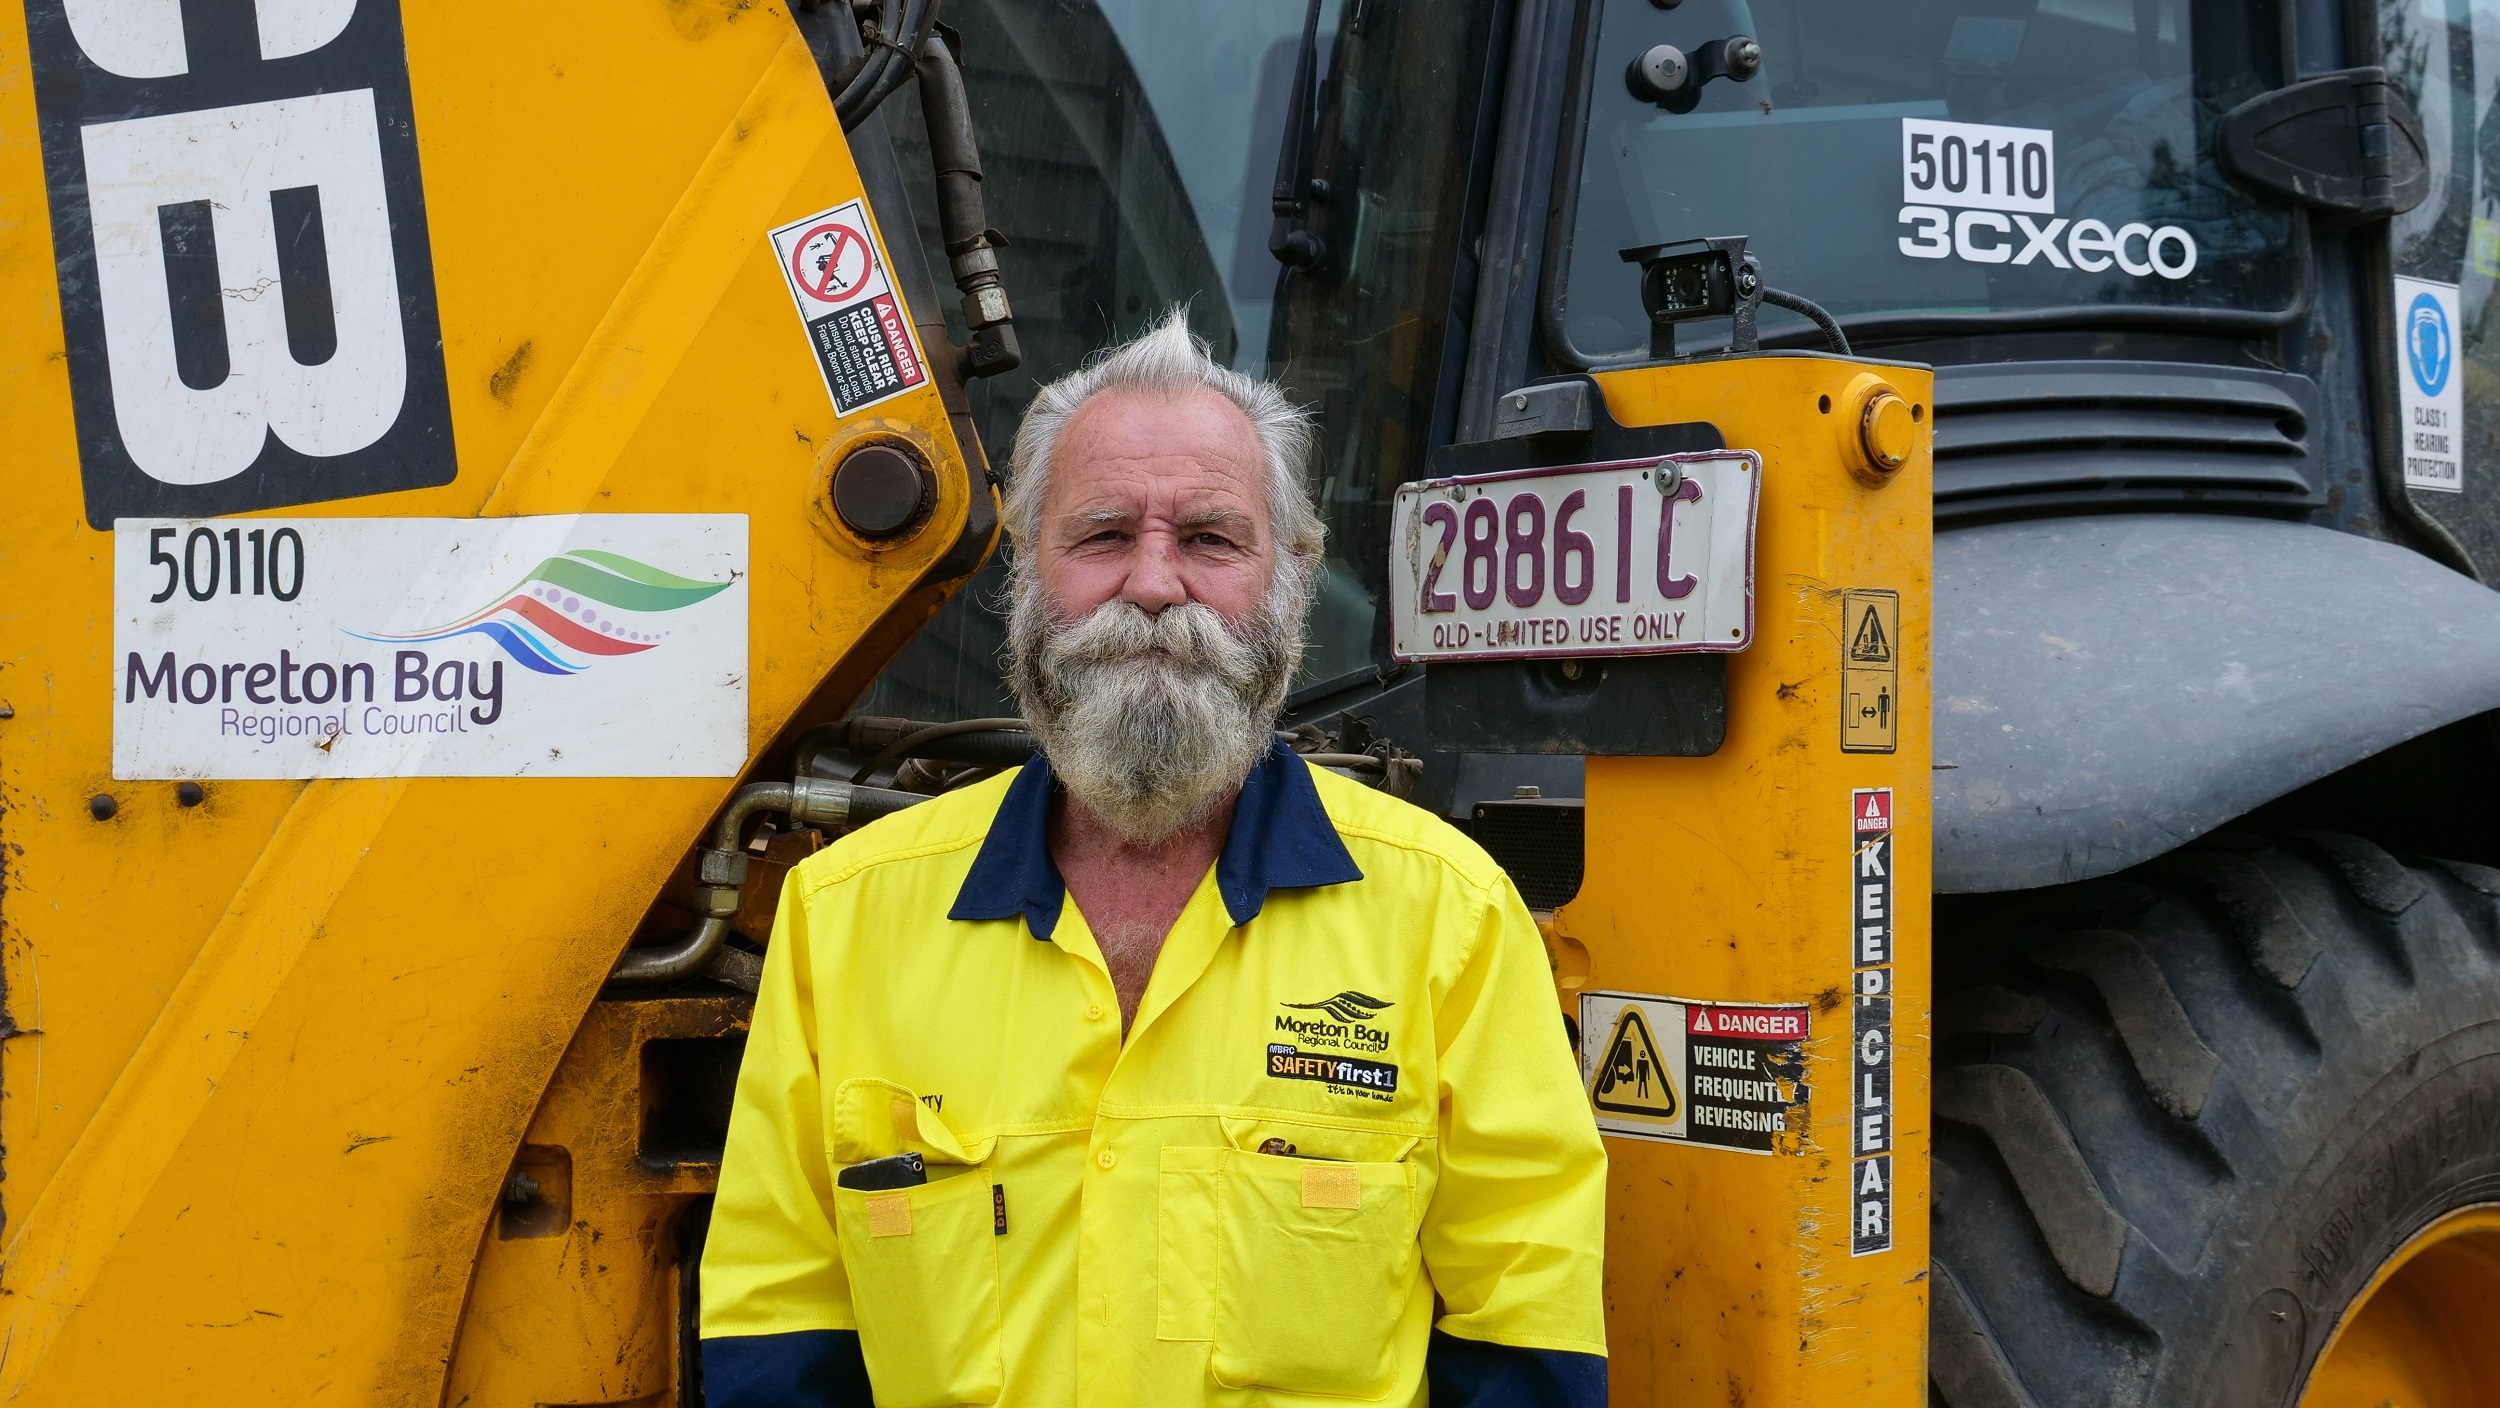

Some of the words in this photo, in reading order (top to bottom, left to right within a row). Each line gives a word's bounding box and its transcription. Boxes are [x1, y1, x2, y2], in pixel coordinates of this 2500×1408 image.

[1910, 132, 2047, 200] 50110
[816, 323, 831, 352] Frame,
[838, 315, 848, 328] Do
[843, 329, 855, 344] not
[849, 344, 865, 369] stand
[858, 369, 873, 393] under
[848, 310, 869, 345] KEEP
[862, 347, 885, 389] CLEAR
[860, 307, 885, 352] CRUSH
[877, 353, 898, 386] RISK
[884, 318, 915, 379] DANGER
[827, 320, 855, 374] unsupported
[848, 374, 863, 399] Load,
[827, 351, 841, 375] Boom
[836, 375, 844, 383] or
[839, 383, 852, 406] Stick.
[2414, 406, 2441, 428] CLASS
[2442, 411, 2448, 429] 1
[2413, 432, 2449, 454] HEARING
[2407, 456, 2456, 480] PROTECTION
[149, 526, 305, 604] 50110
[1579, 614, 1623, 643] USE
[1633, 609, 1686, 640] ONLY
[125, 649, 375, 705] Moreton
[394, 650, 503, 726] Bay
[221, 707, 352, 745] Regional
[363, 704, 469, 737] Council
[1857, 817, 1888, 831] DANGER
[1861, 840, 1886, 1006] KEEP
[1275, 1015, 1349, 1038] Moreton
[1354, 1024, 1390, 1051] Bay
[1718, 1013, 1799, 1034] DANGER
[1269, 1044, 1295, 1055] MBRC
[1298, 1033, 1340, 1047] Regional
[1344, 1038, 1380, 1053] Council
[1694, 1045, 1756, 1071] VEHICLE
[1694, 1104, 1786, 1133] REVERSING
[1859, 1029, 1885, 1238] CLEAR
[995, 1193, 1006, 1228] DNC
